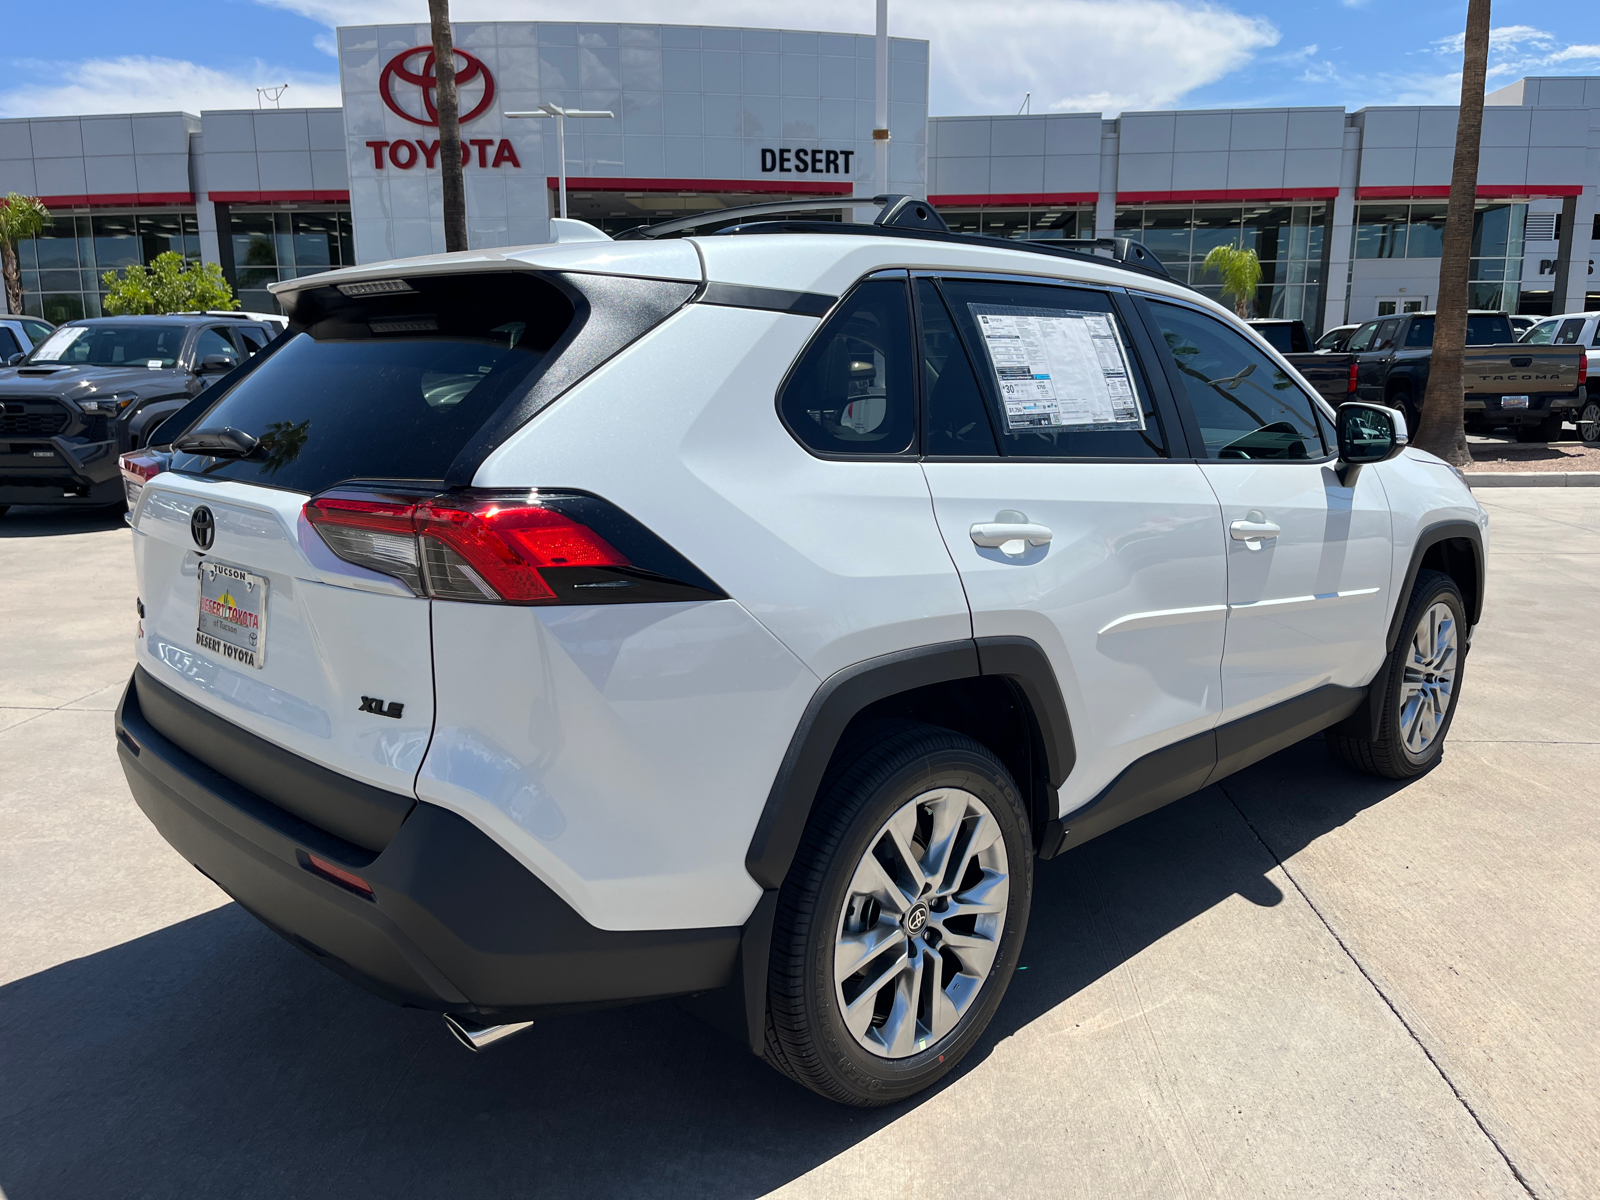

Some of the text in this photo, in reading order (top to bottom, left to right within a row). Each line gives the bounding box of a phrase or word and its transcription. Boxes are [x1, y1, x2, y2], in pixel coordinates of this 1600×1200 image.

[761, 149, 854, 173] DESERT
[213, 564, 246, 581] TUCSON
[200, 595, 259, 630] DESERT TOYOTA
[213, 619, 238, 635] of Tucson
[195, 632, 255, 667] DESERT TOYOTA
[358, 695, 405, 720] XLE
